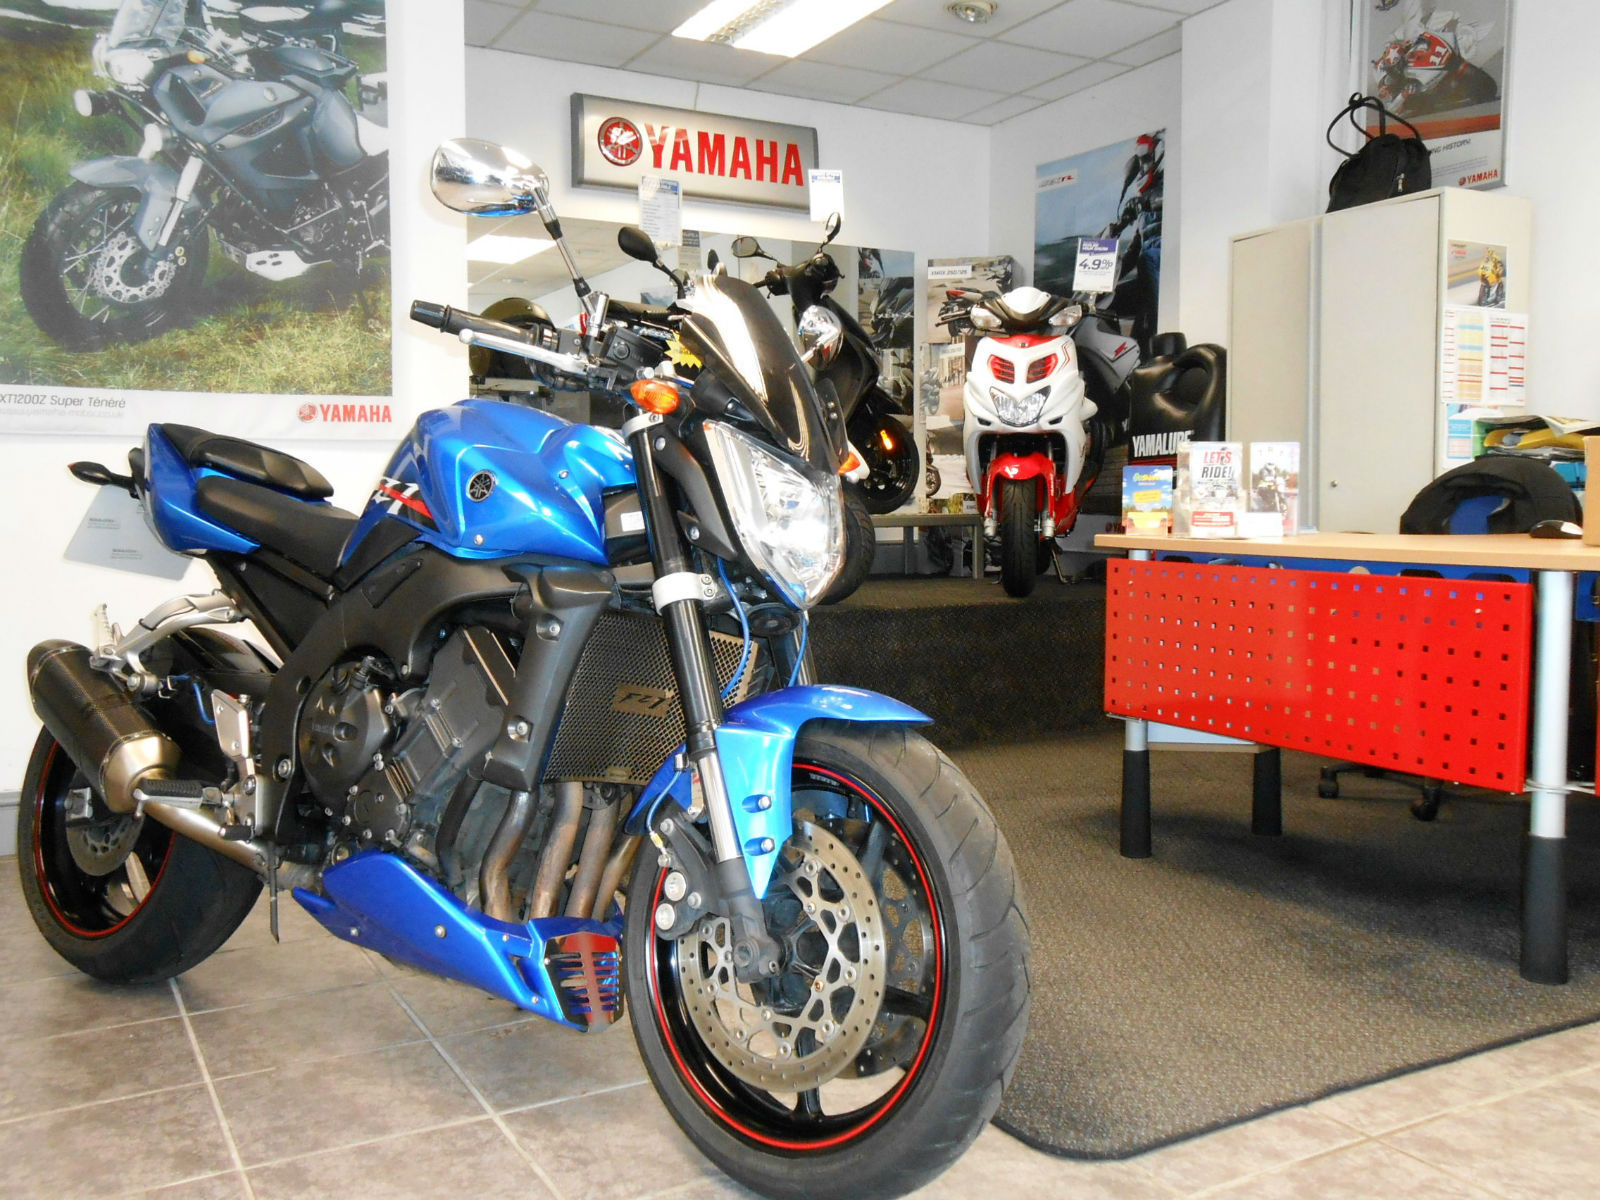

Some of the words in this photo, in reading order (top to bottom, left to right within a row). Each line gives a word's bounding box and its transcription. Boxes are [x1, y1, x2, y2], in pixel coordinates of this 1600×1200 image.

[645, 122, 804, 186] YAMAHA
[1467, 169, 1498, 184] YAMAHA
[0, 394, 47, 405] XT1200Z
[50, 396, 84, 408] Super
[320, 404, 392, 422] YAMAHA
[1201, 466, 1232, 478] RIDE!
